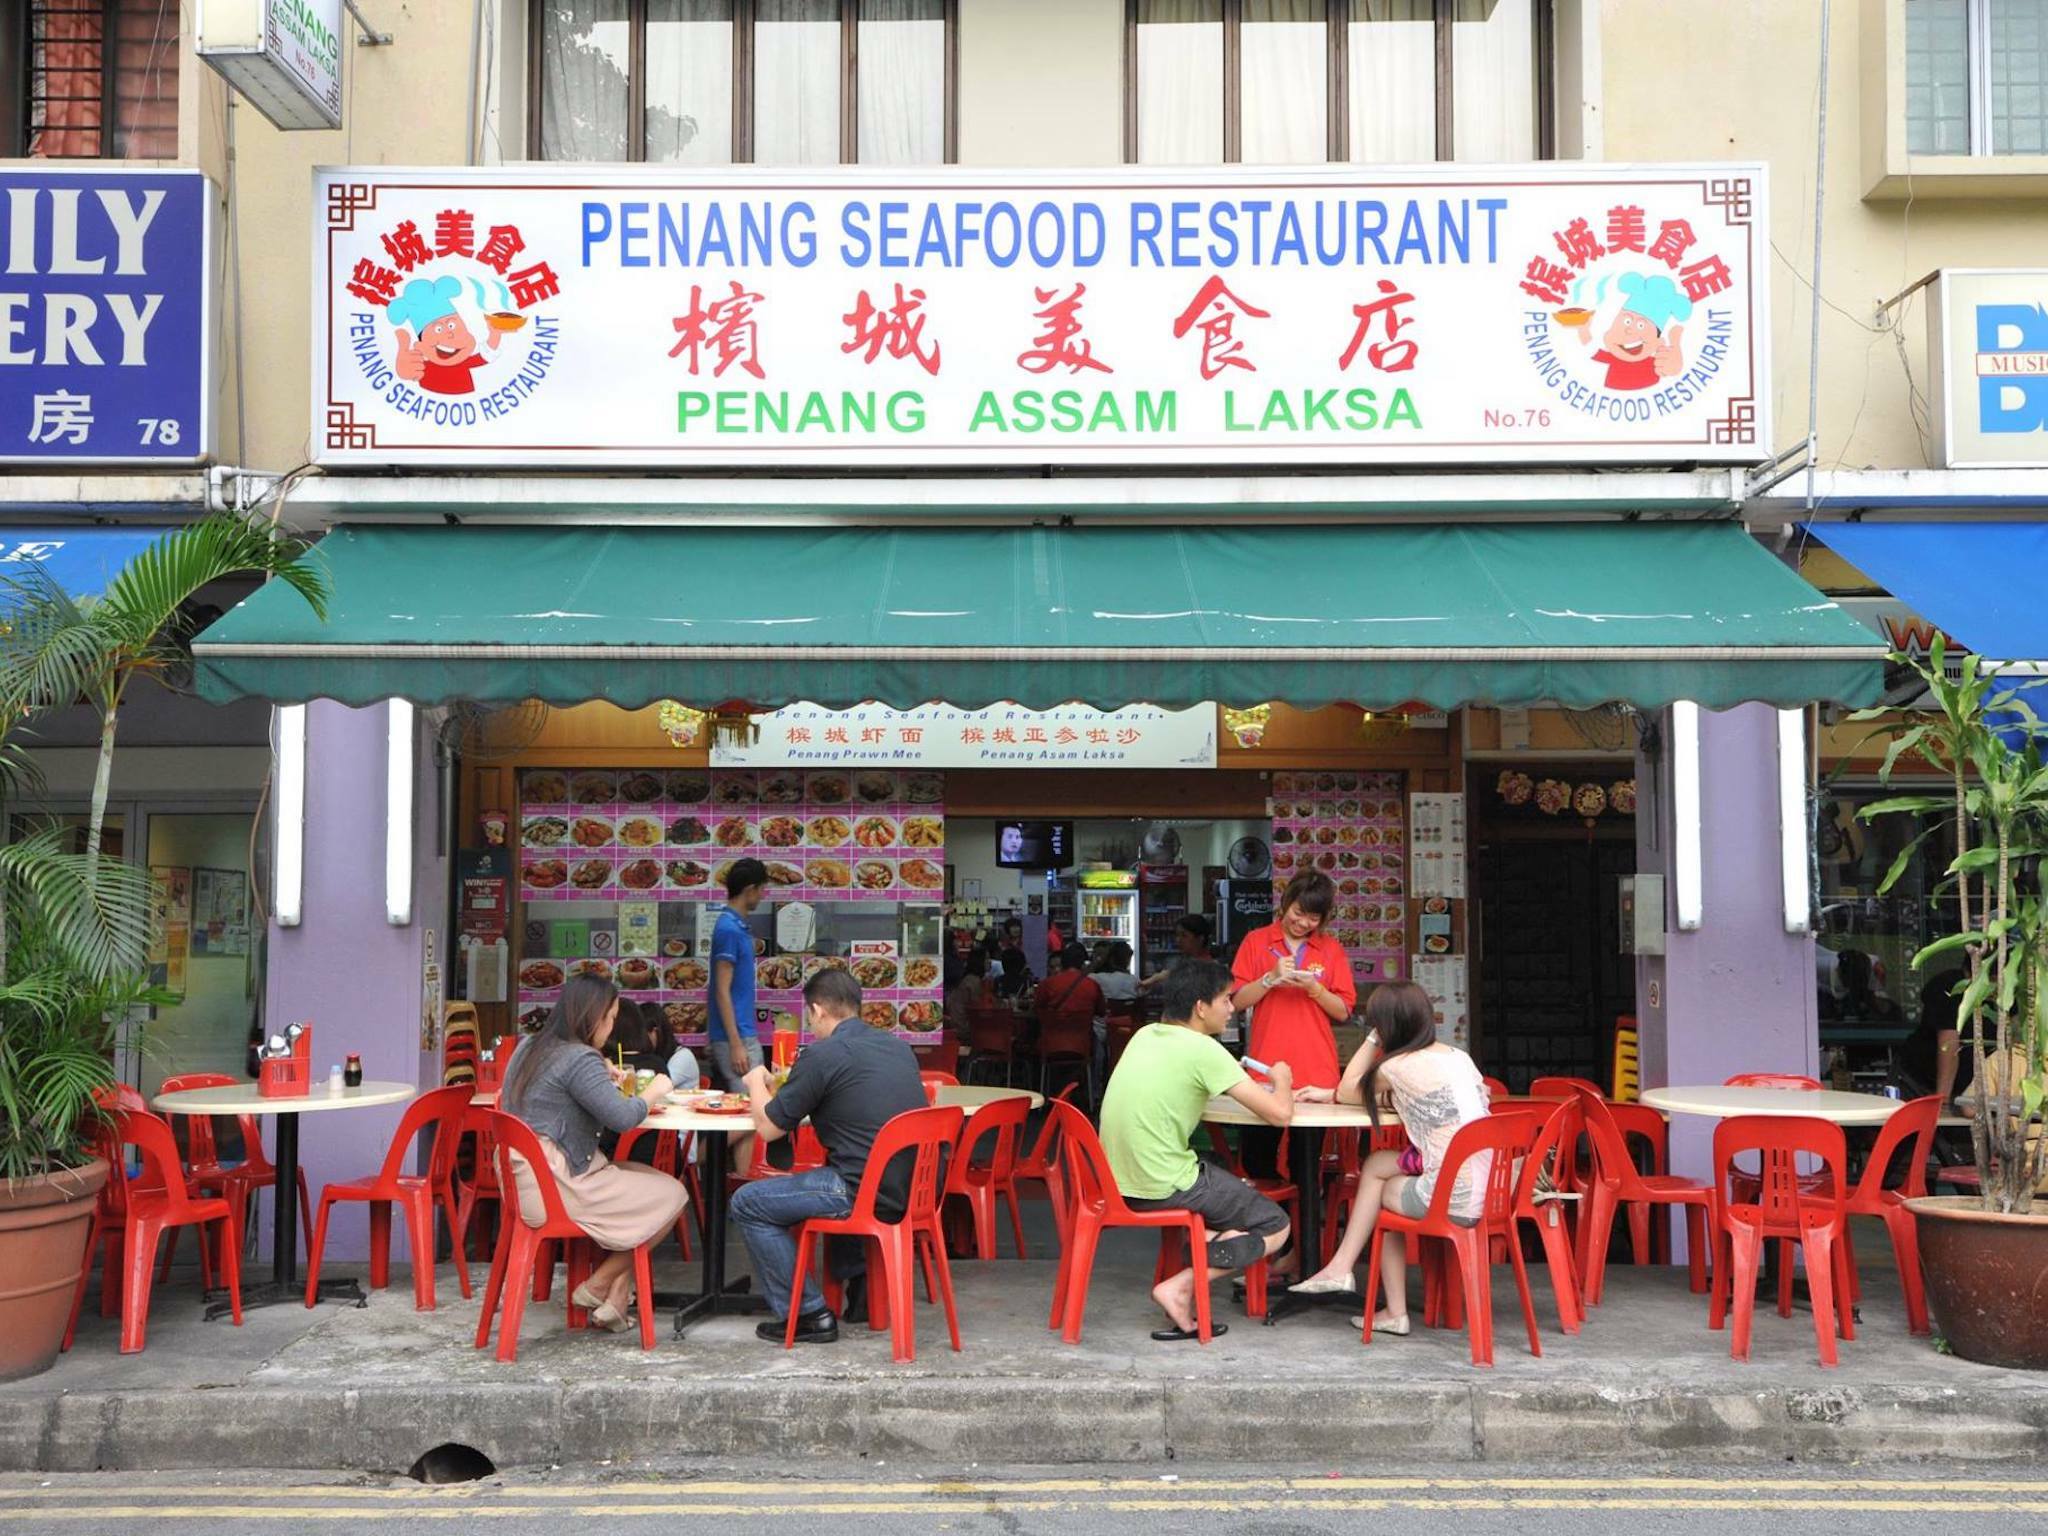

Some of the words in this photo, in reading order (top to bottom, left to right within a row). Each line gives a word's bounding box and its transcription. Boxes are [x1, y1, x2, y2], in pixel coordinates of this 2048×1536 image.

[272, 2, 306, 47] ASSAM
[308, 38, 337, 80] LAKSA
[581, 201, 817, 268] PENANG
[840, 201, 1106, 268] SEAFOOD
[1130, 198, 1508, 267] RESTAURANT
[0, 293, 164, 366] ERY
[350, 312, 394, 391] PENANG
[385, 382, 477, 427] SEAFOOD
[479, 315, 560, 422] RESTAURANT
[1523, 311, 1567, 388] PENANG
[1559, 379, 1651, 422] SEAFOOD
[1652, 308, 1733, 417] RESTAURANT
[1991, 356, 2048, 373] MUSI
[27, 389, 94, 445] 房
[677, 390, 926, 434] PENANG
[968, 390, 1177, 434] ASSAM
[1225, 387, 1423, 433] LAKSA
[1484, 408, 1551, 428] No.76
[137, 419, 181, 446] 78
[0, 541, 66, 563] E
[775, 710, 867, 720] Penang
[884, 710, 989, 720] Seafood
[787, 749, 840, 761] Penang
[843, 749, 889, 759] Prawn
[892, 749, 922, 759] Mee
[980, 749, 1034, 761] Penang
[1039, 749, 1078, 760] Asam
[1083, 749, 1125, 760] Laksa
